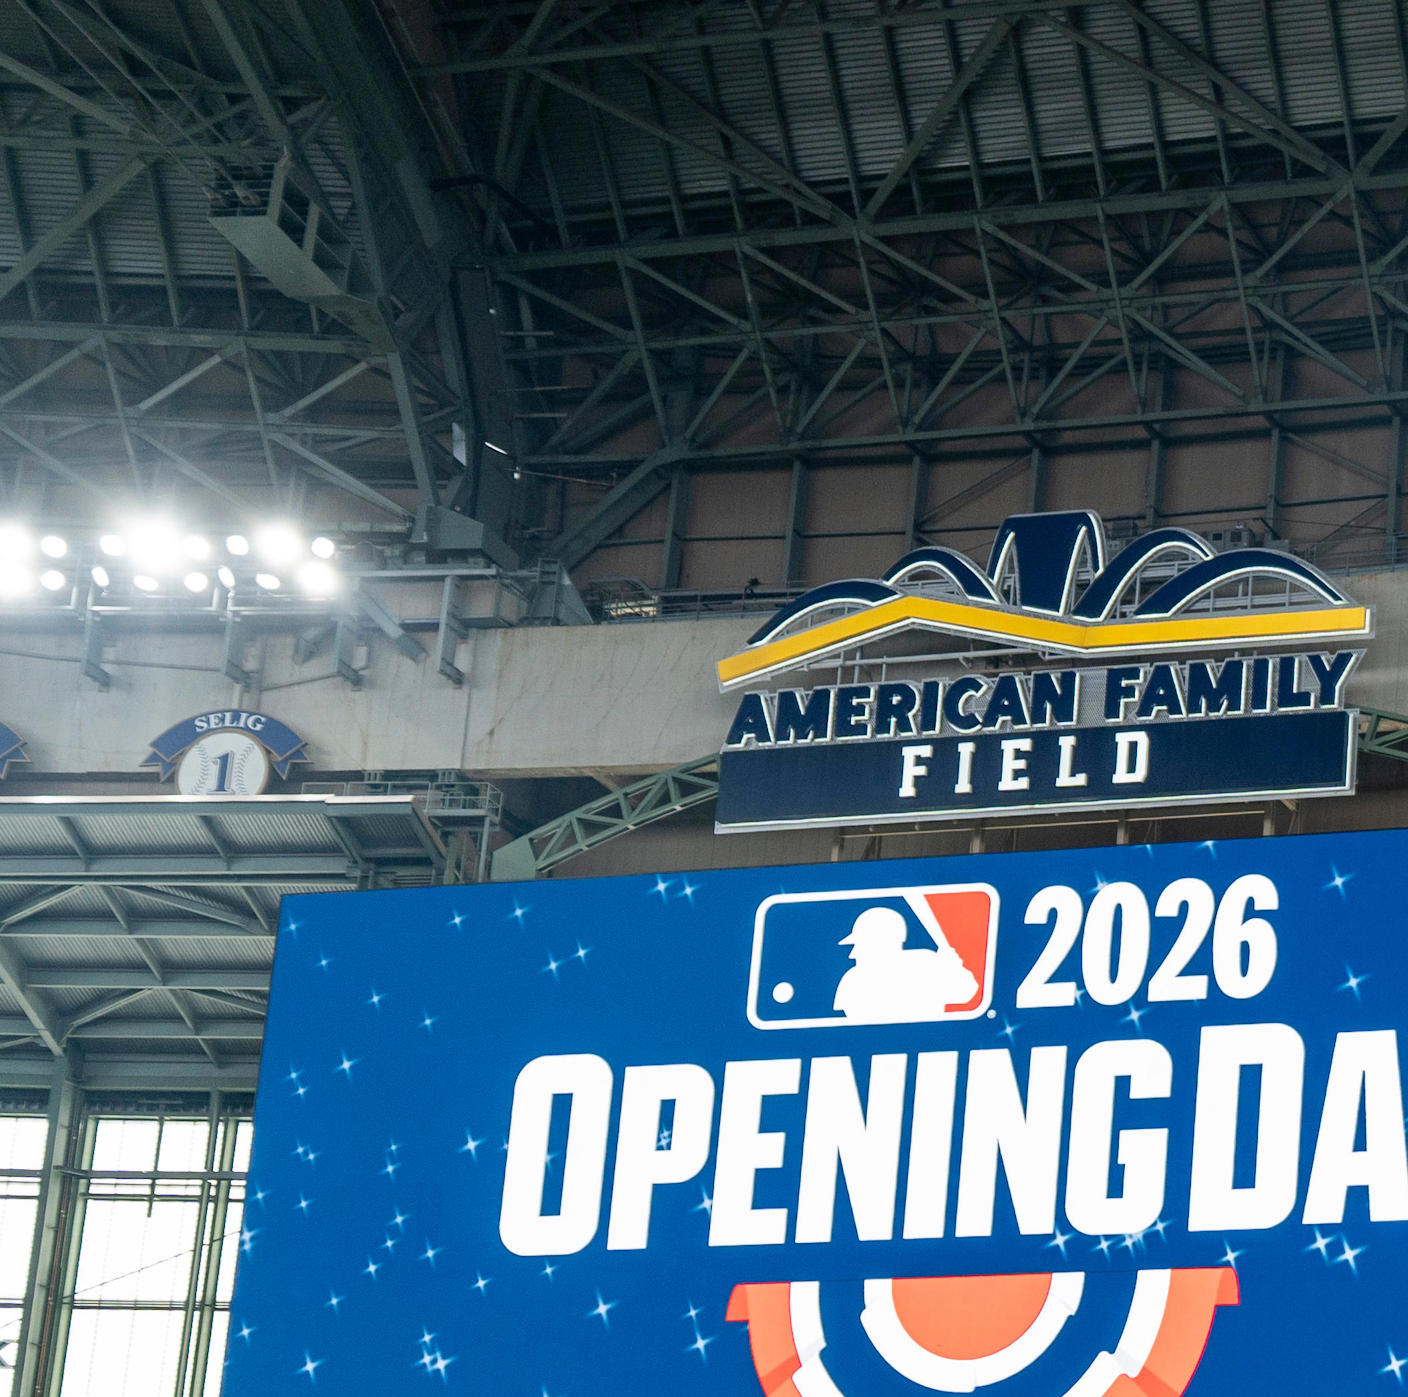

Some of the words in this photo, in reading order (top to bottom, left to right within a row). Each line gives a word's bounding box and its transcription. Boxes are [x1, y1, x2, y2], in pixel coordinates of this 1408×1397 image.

[194, 711, 266, 732] SELIG
[725, 669, 1083, 749] AMERICAN
[1104, 649, 1362, 723] FAMILY
[208, 750, 236, 795] 1
[898, 731, 1150, 799] FIELD
[1015, 875, 1279, 1009] 2026
[499, 1038, 1175, 1257] OPENING
